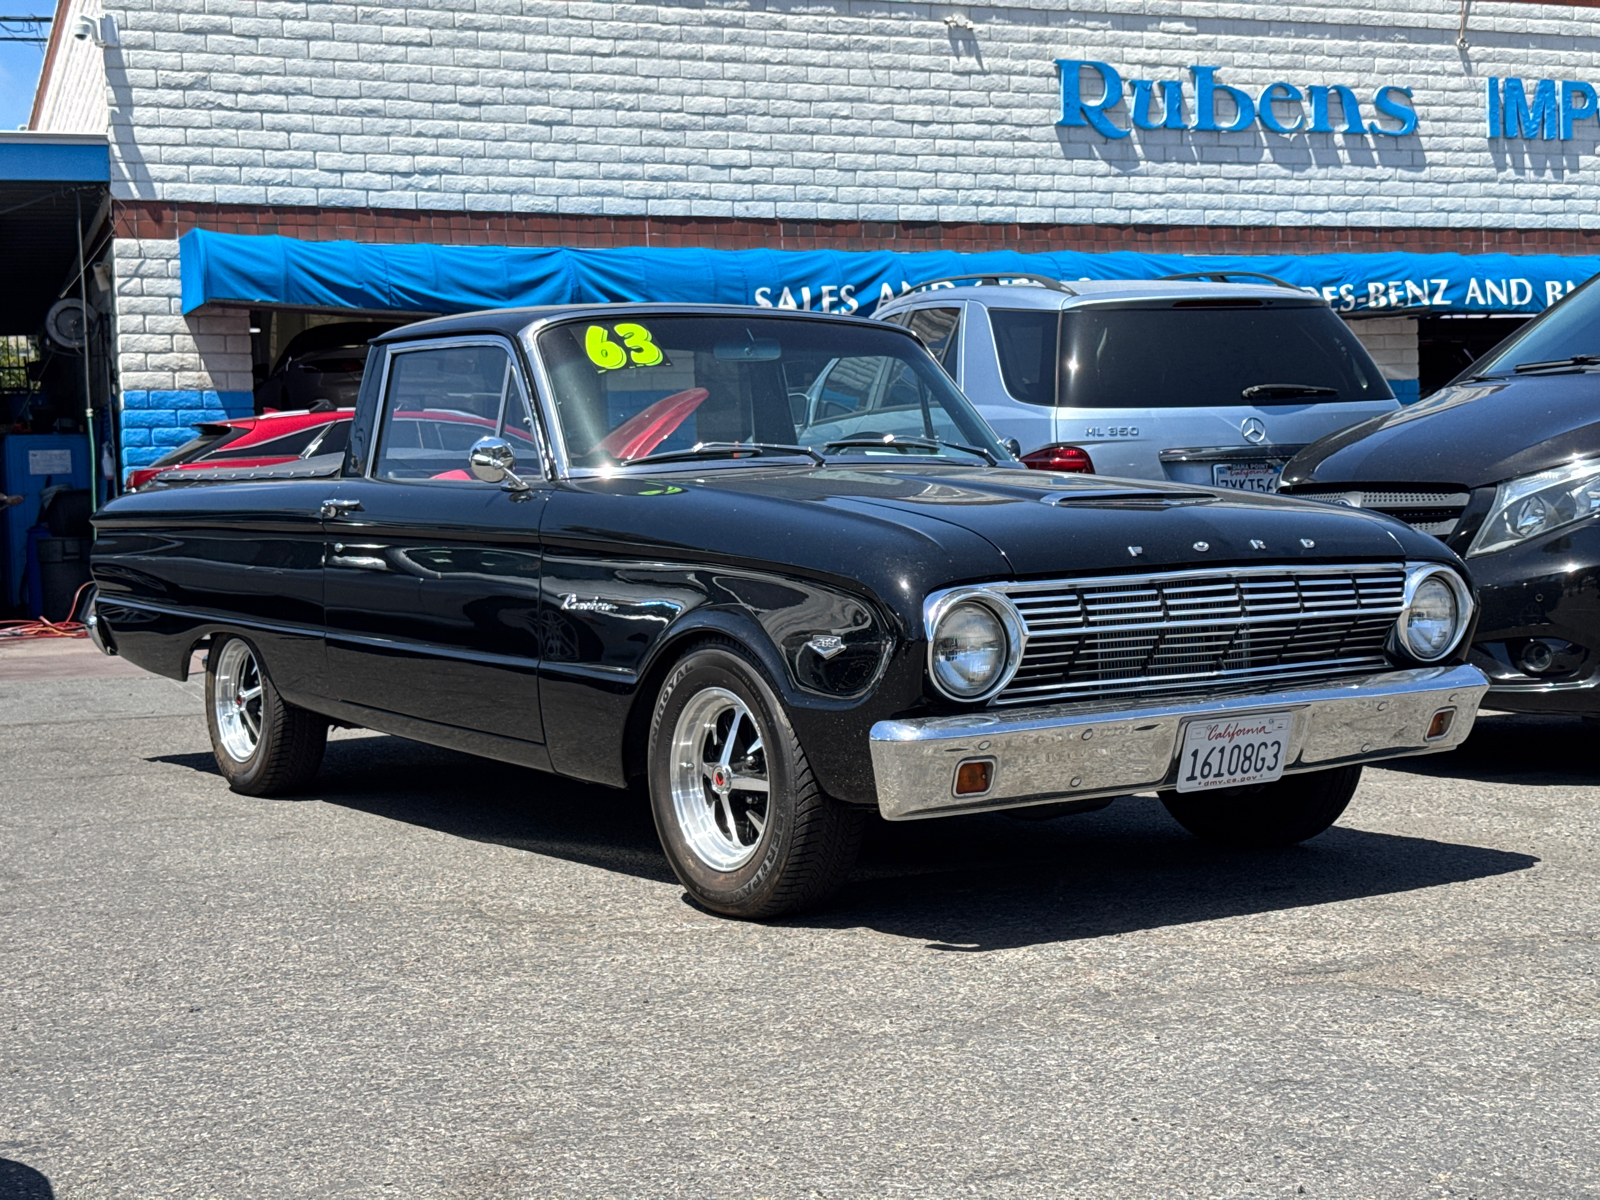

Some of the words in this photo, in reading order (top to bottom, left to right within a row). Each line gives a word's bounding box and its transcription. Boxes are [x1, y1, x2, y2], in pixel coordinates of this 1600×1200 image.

[1053, 58, 1419, 140] Rubens
[1485, 76, 1600, 141] IMP
[1464, 277, 1533, 306] AND
[585, 323, 664, 370] 63
[1108, 425, 1140, 437] 350
[1127, 538, 1316, 557] FORD
[1207, 722, 1273, 744] California
[1185, 740, 1282, 782] 16108G3
